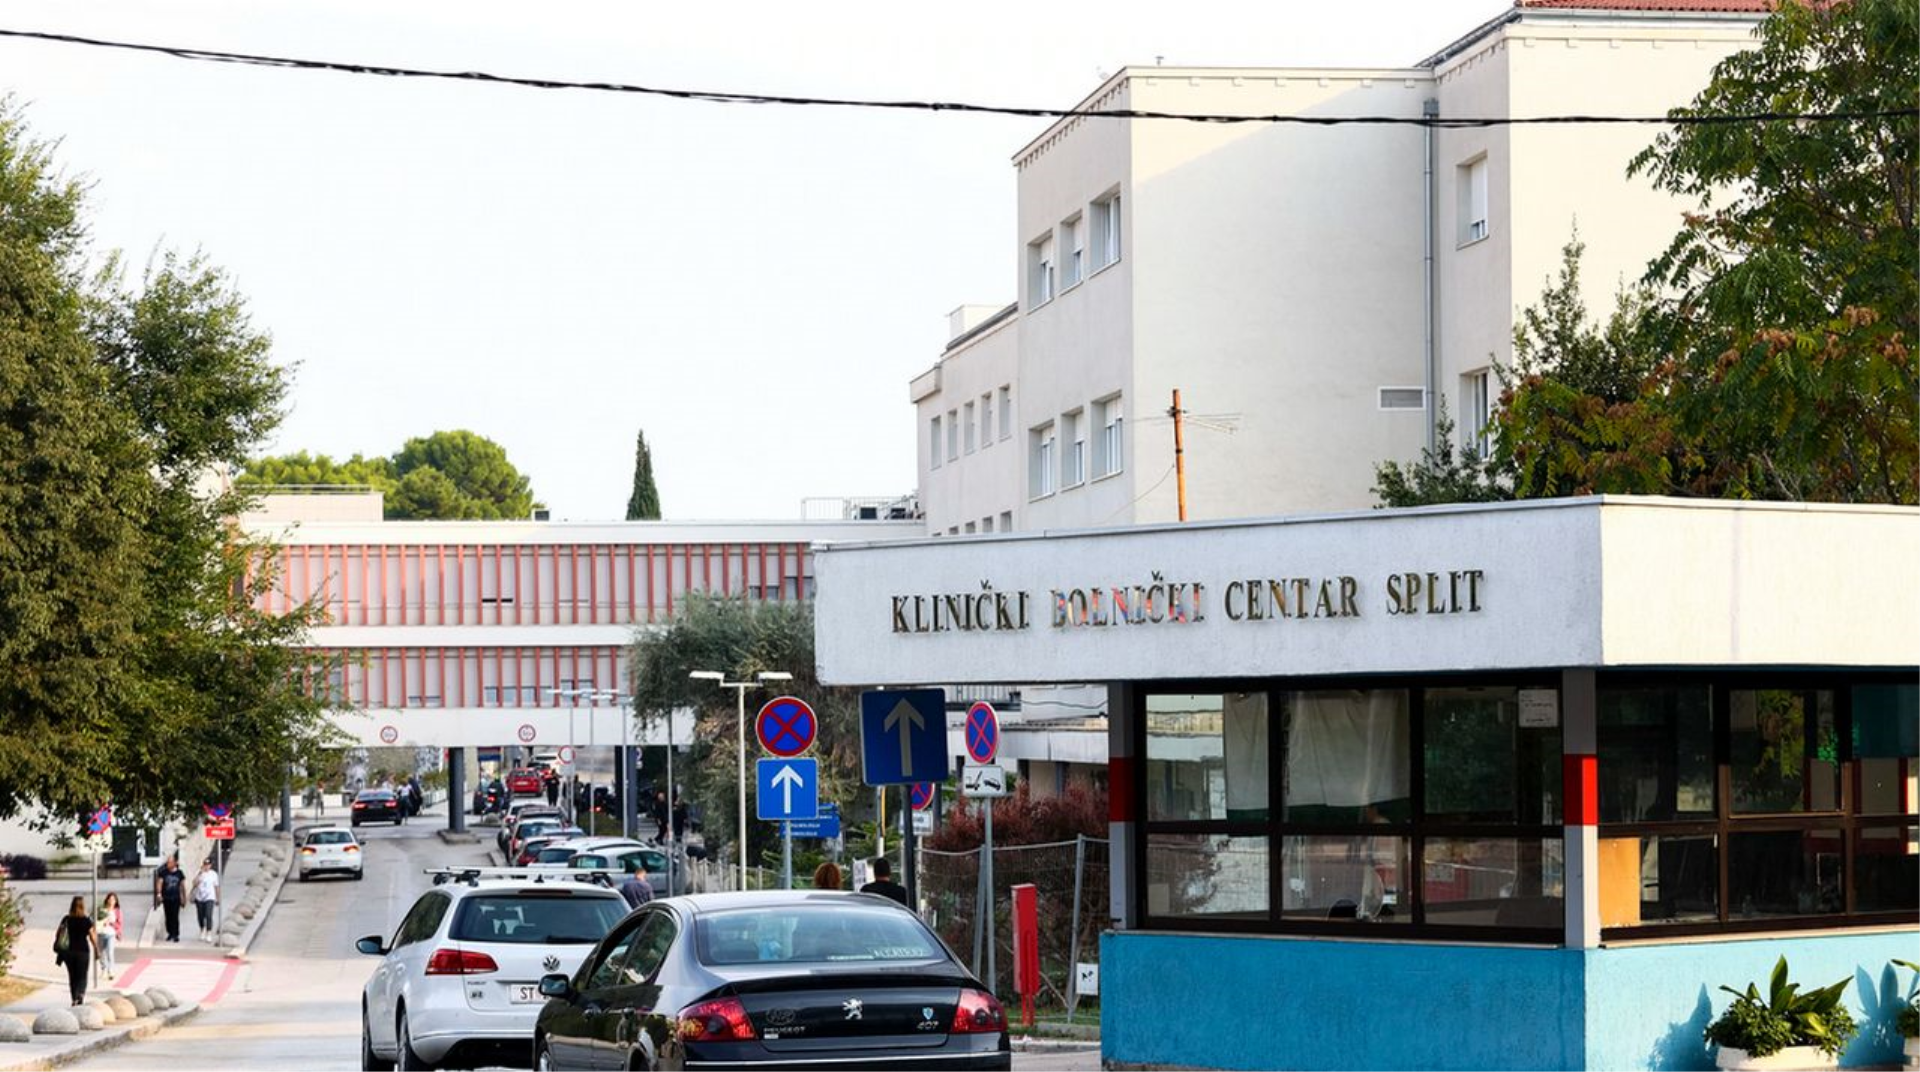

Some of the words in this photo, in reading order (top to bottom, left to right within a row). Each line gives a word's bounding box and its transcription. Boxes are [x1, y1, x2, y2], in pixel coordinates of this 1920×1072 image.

[891, 579, 1029, 633] KLINIČKI
[1050, 570, 1204, 628] BOLNIČKI
[1225, 576, 1360, 621] CENTAR
[1386, 570, 1484, 615] SPLIT
[520, 987, 534, 1000] ST
